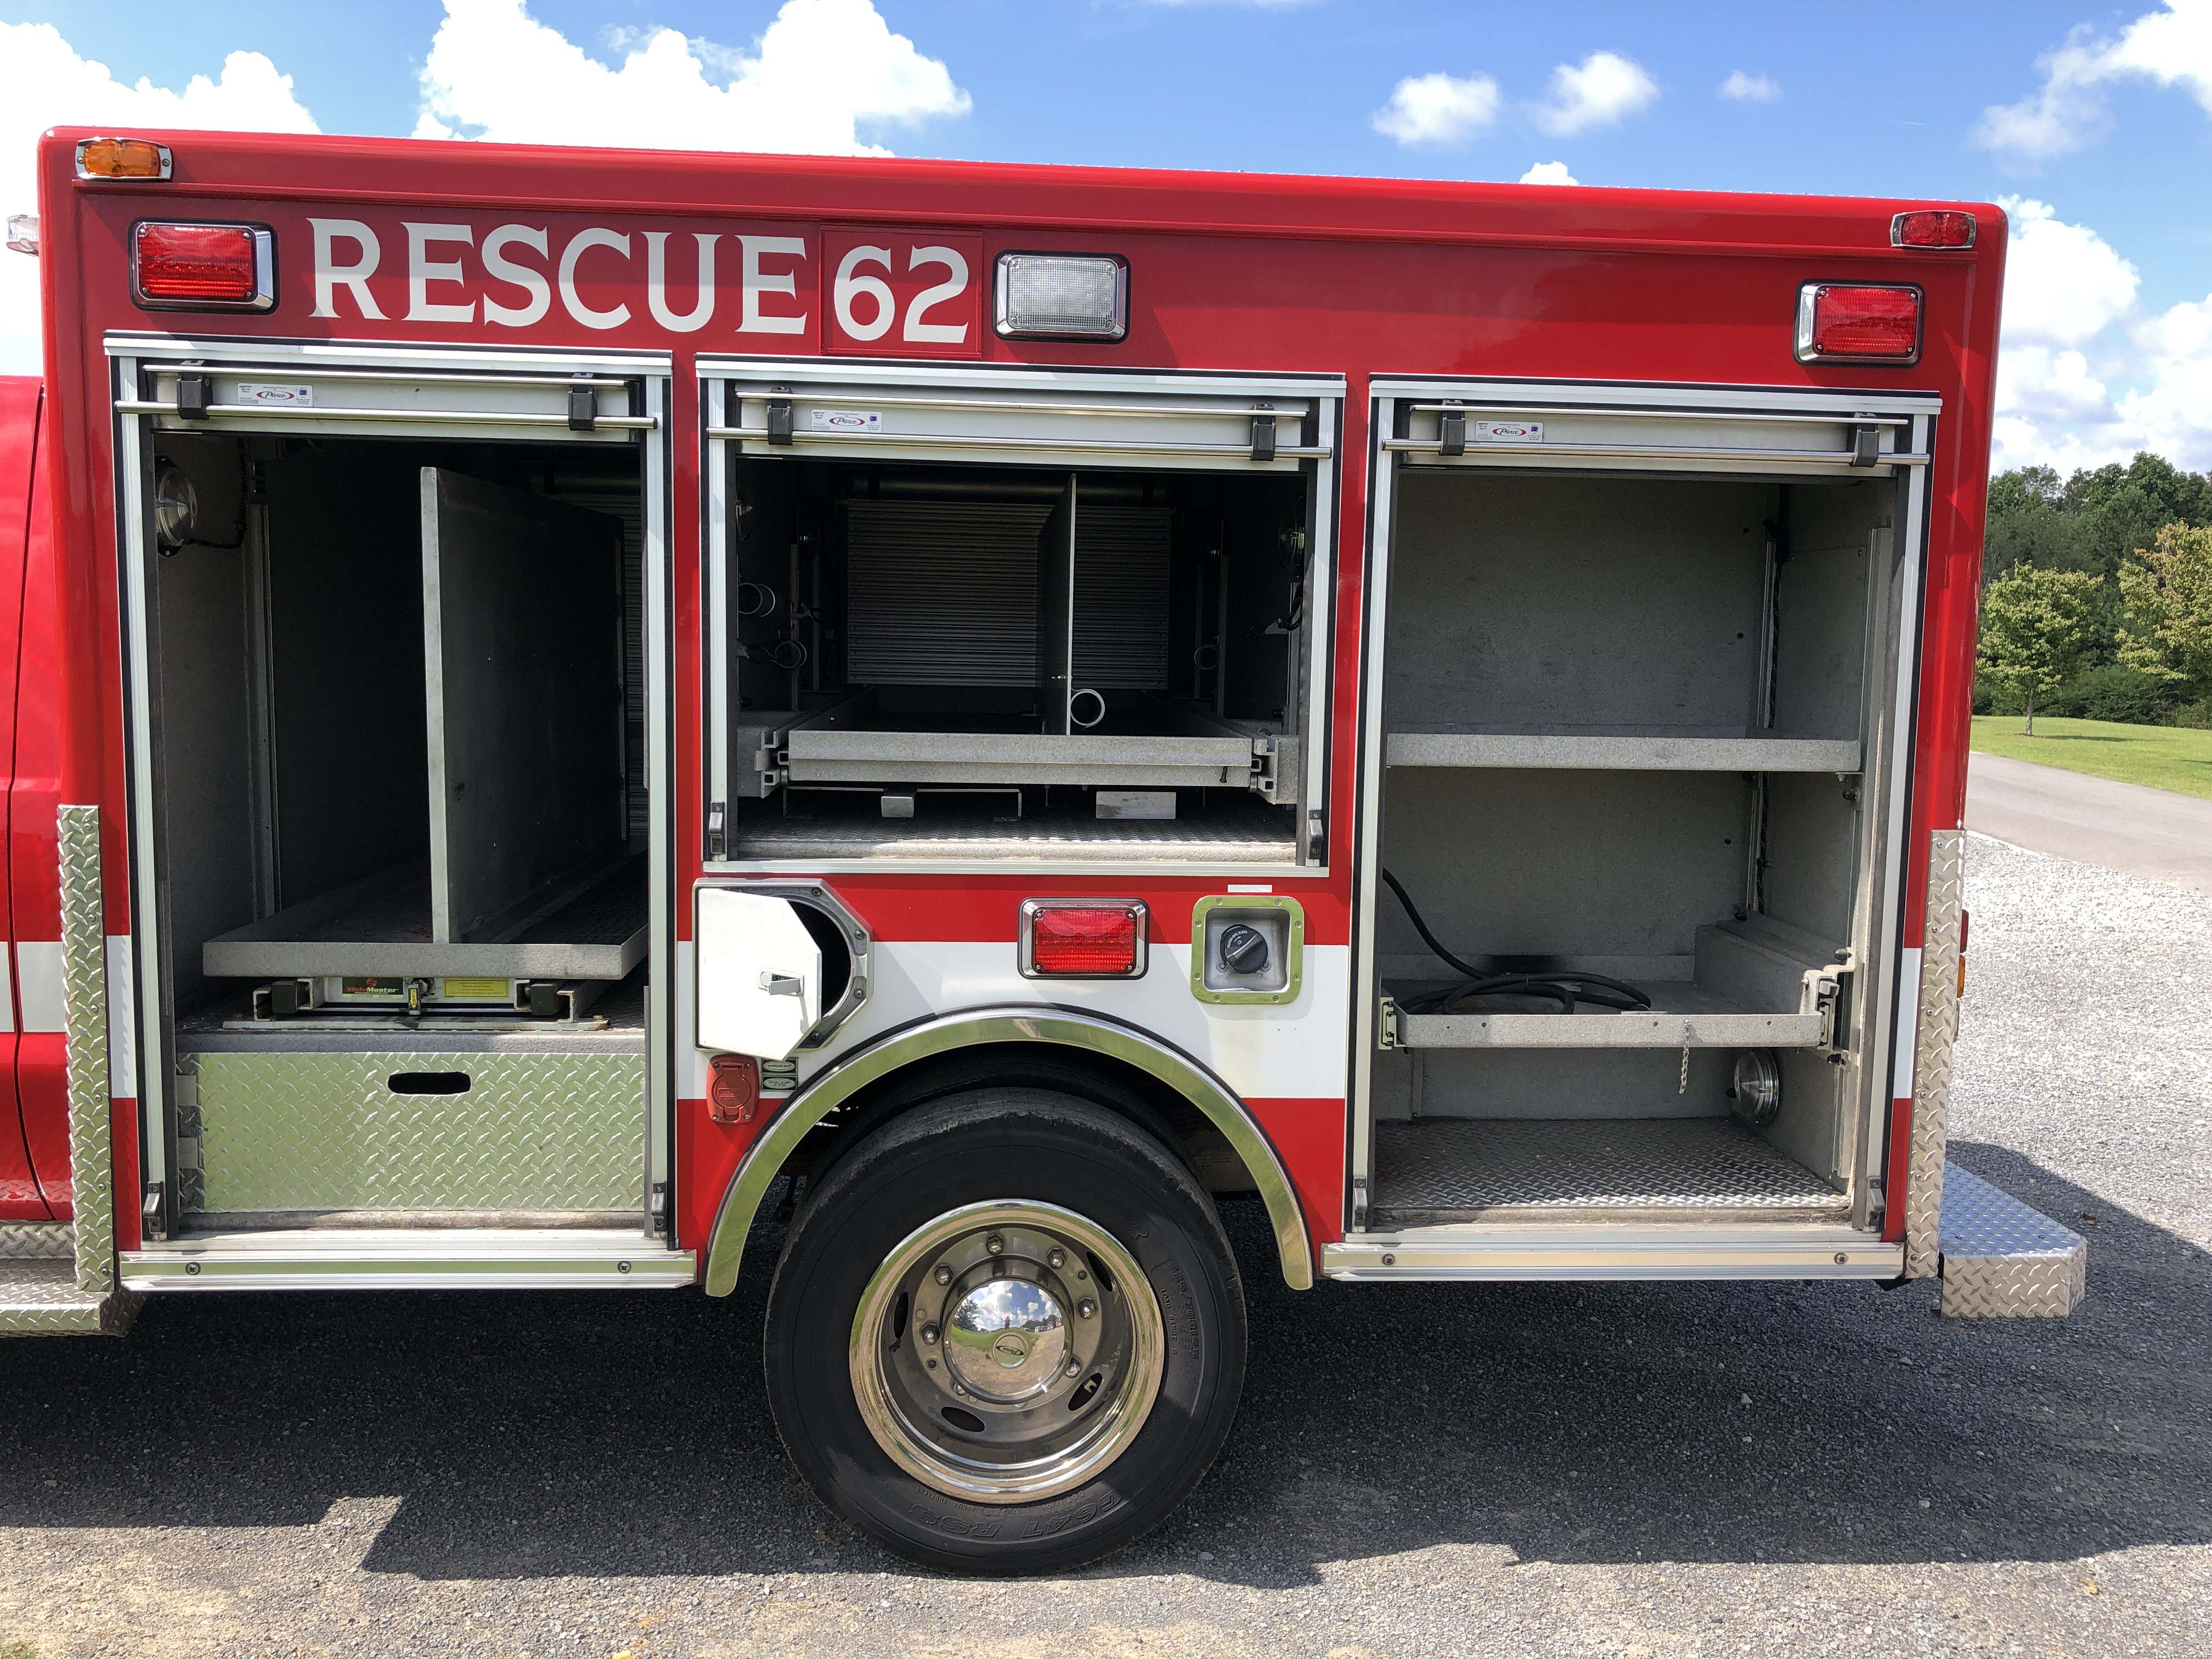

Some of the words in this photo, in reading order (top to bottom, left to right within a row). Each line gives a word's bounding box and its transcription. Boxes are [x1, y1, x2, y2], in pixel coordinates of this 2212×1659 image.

[306, 218, 808, 335] RESCUE
[833, 245, 969, 344] 62
[264, 391, 286, 399] Pierce
[837, 417, 857, 426] Pierce
[1161, 1288, 1172, 1308] LOAD
[1169, 1314, 1177, 1341] RANGE
